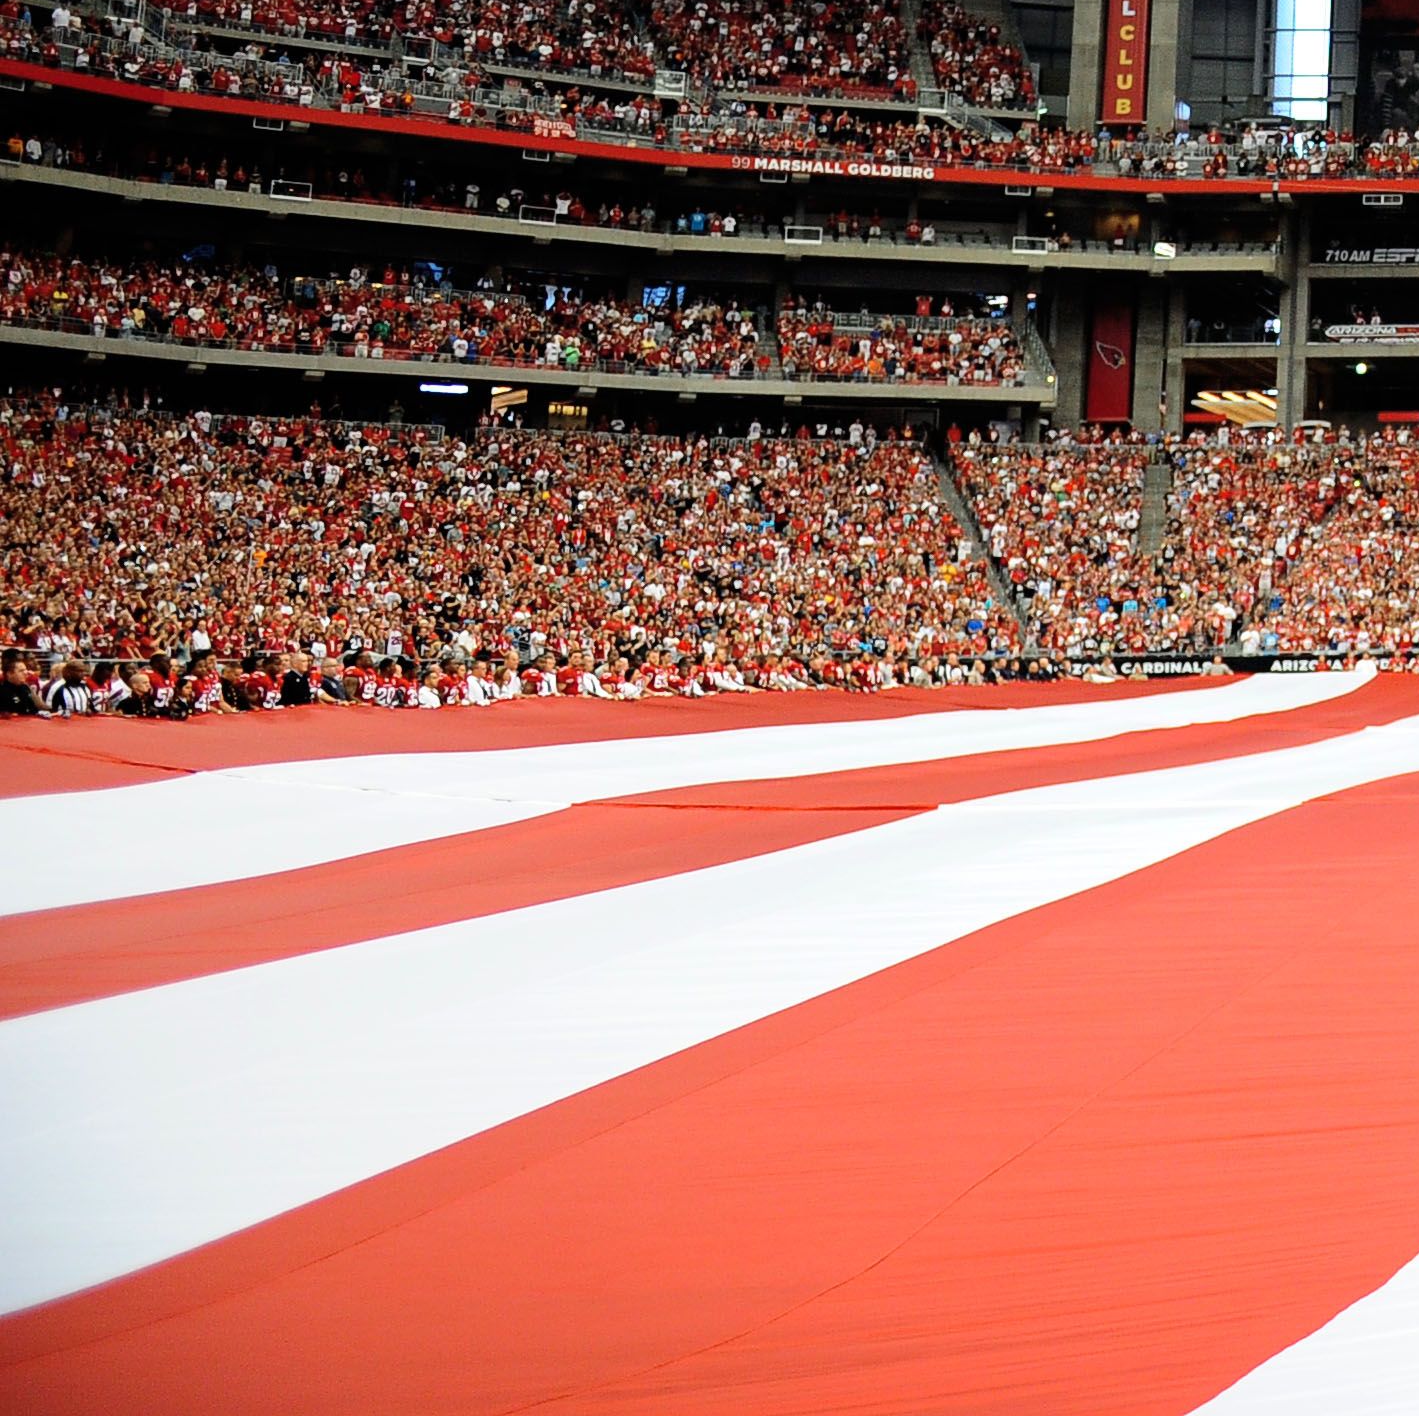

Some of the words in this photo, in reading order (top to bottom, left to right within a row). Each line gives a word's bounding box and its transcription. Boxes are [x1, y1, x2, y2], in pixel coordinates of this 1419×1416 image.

[1115, 24, 1135, 115] CLUB
[731, 156, 750, 169] 99
[754, 158, 844, 174] MARSHALL
[848, 164, 935, 179] GOLDBERG
[1325, 250, 1348, 262] 710
[1350, 250, 1371, 261] AM
[1270, 659, 1344, 672] ARIZOA
